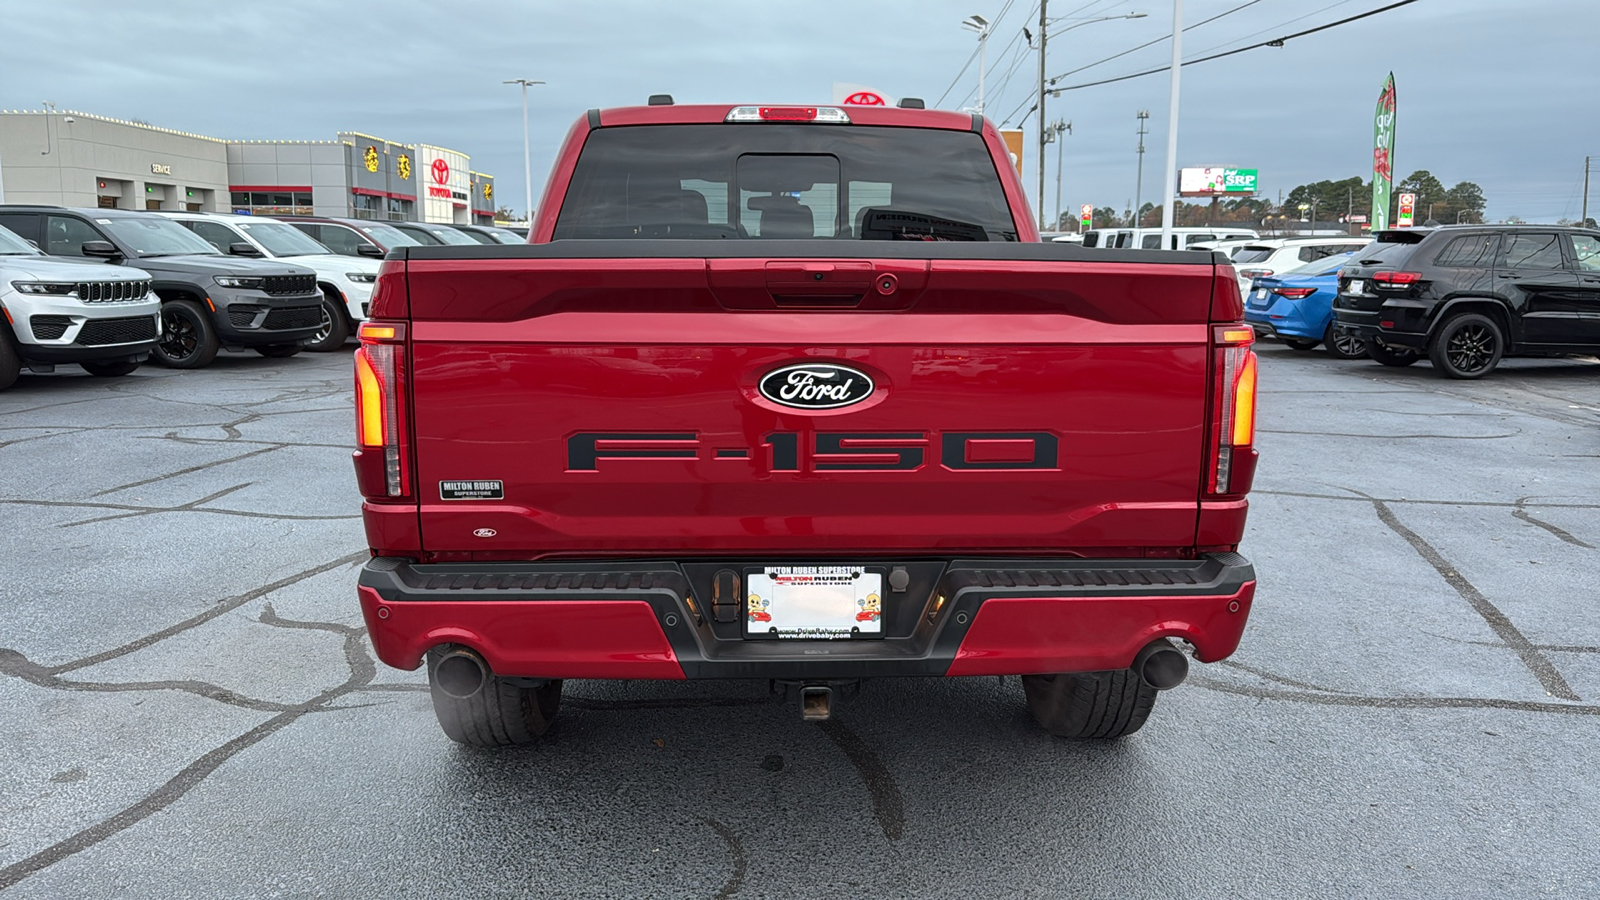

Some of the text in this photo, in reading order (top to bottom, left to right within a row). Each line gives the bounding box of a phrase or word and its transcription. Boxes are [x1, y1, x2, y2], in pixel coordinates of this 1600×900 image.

[151, 163, 171, 175] SERVICE
[1226, 175, 1255, 185] SRP
[428, 187, 451, 198] TOYOTA
[779, 369, 853, 402] Ford
[564, 430, 1061, 472] F-150
[444, 482, 500, 490] MILTON RUBEN
[764, 566, 865, 574] MILTON RUBEN SUPERSTORE
